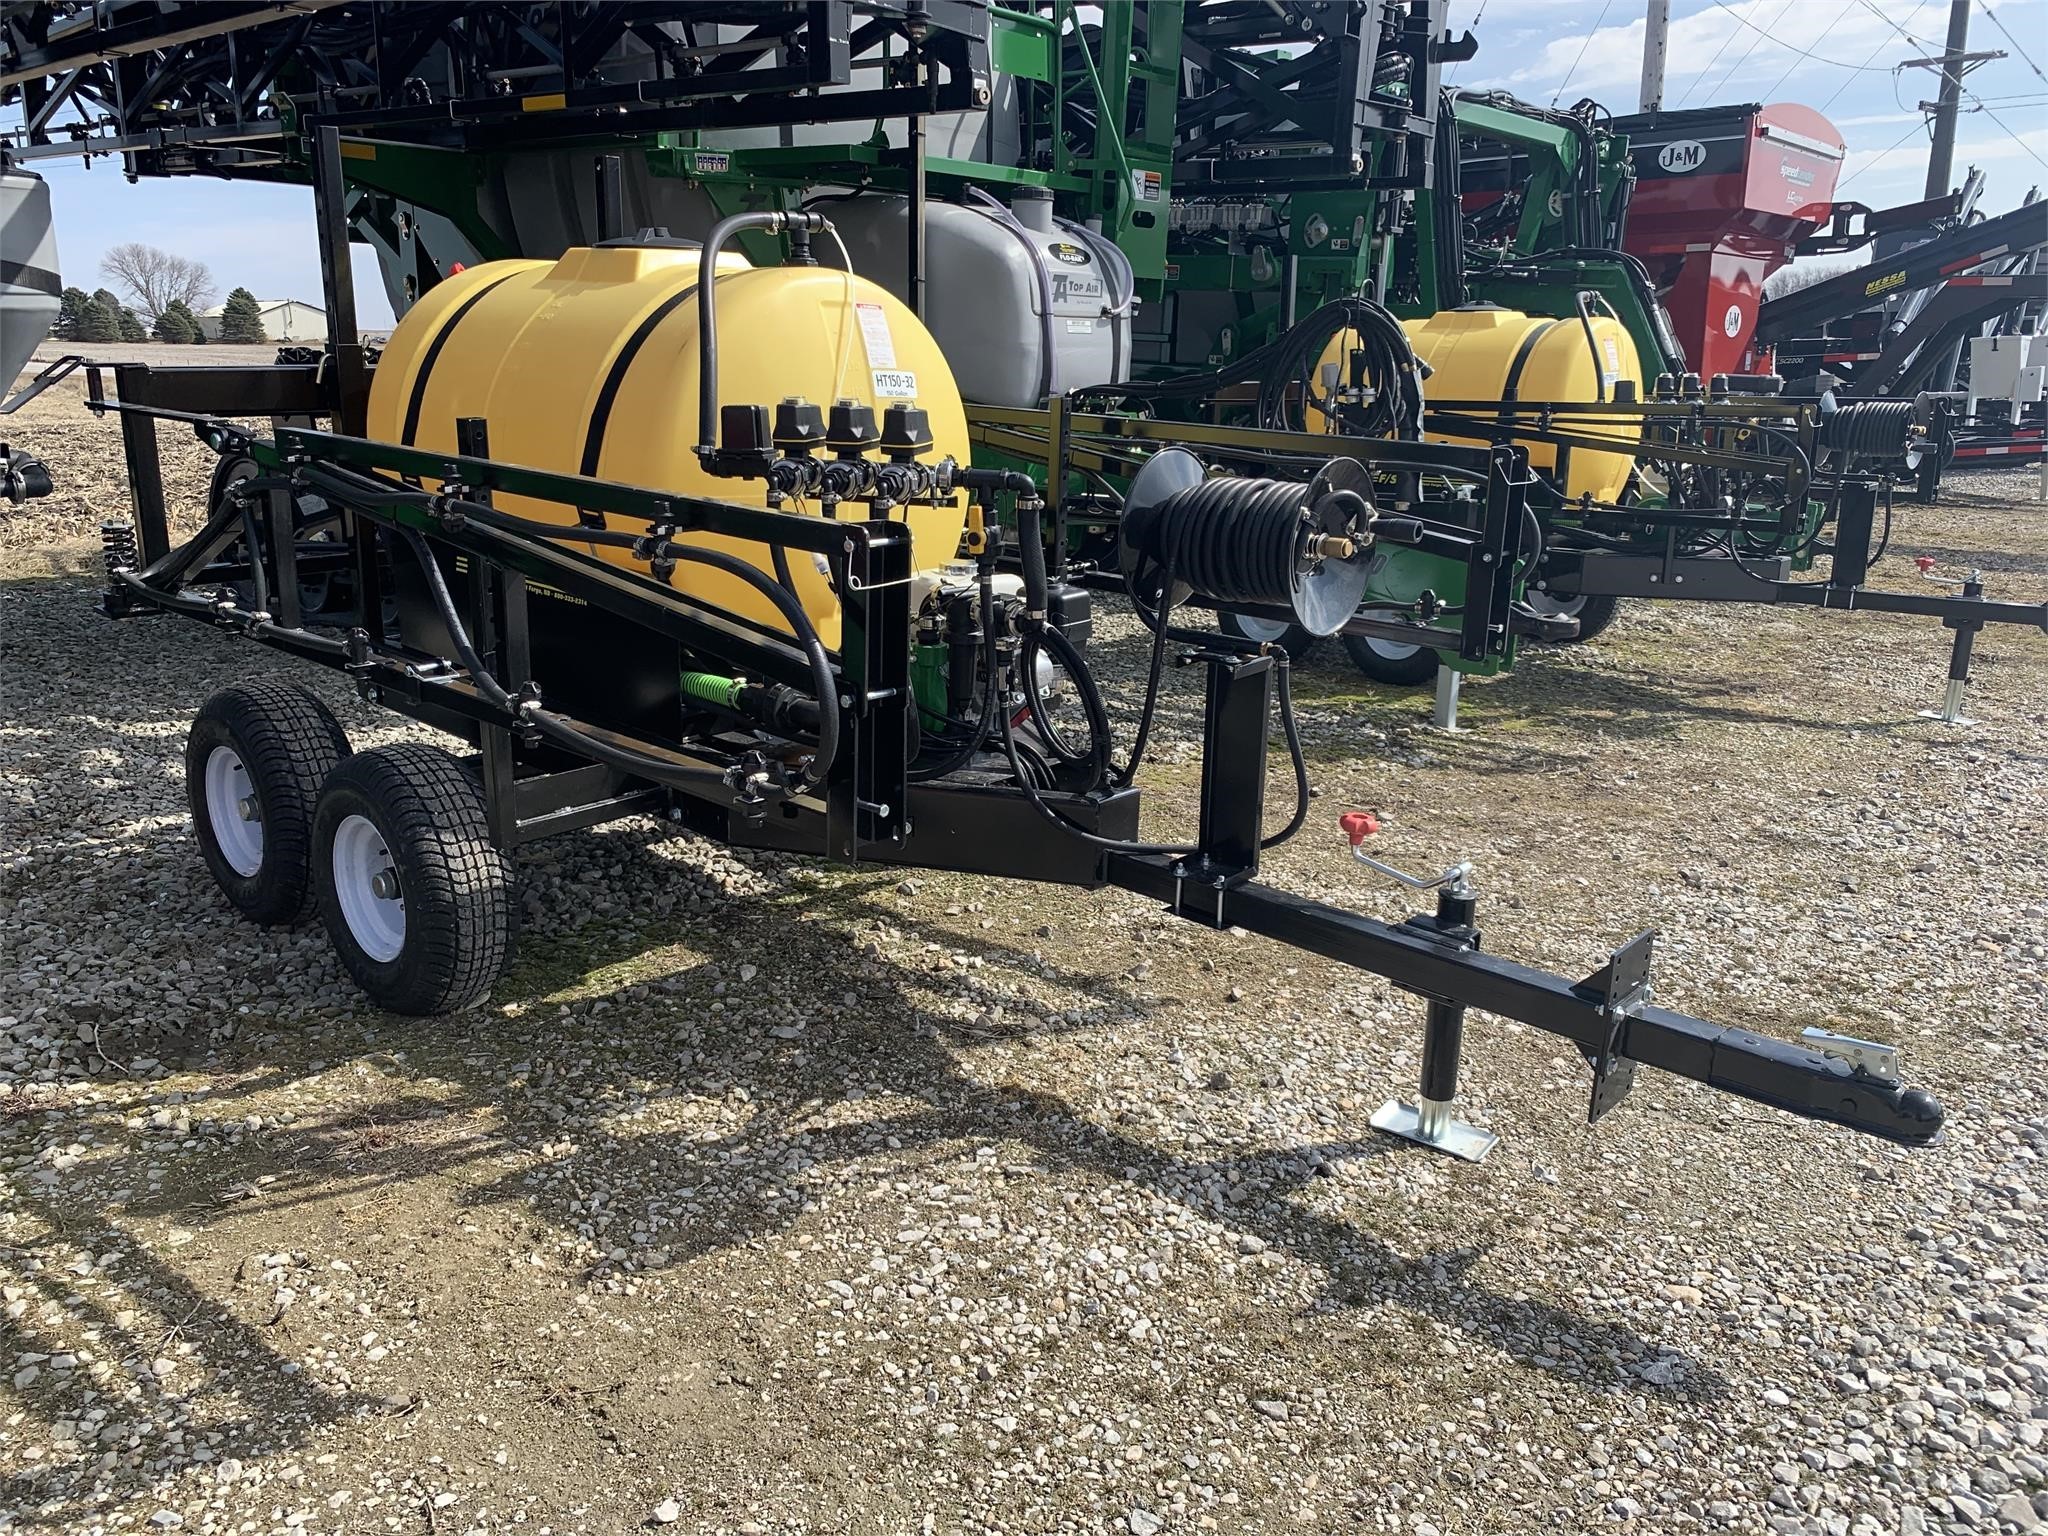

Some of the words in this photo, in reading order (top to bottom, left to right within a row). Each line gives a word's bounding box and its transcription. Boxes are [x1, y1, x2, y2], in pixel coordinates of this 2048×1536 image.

[1662, 144, 1699, 168] J&M
[1866, 270, 1906, 290] NESSA
[876, 374, 914, 389] HT150-32
